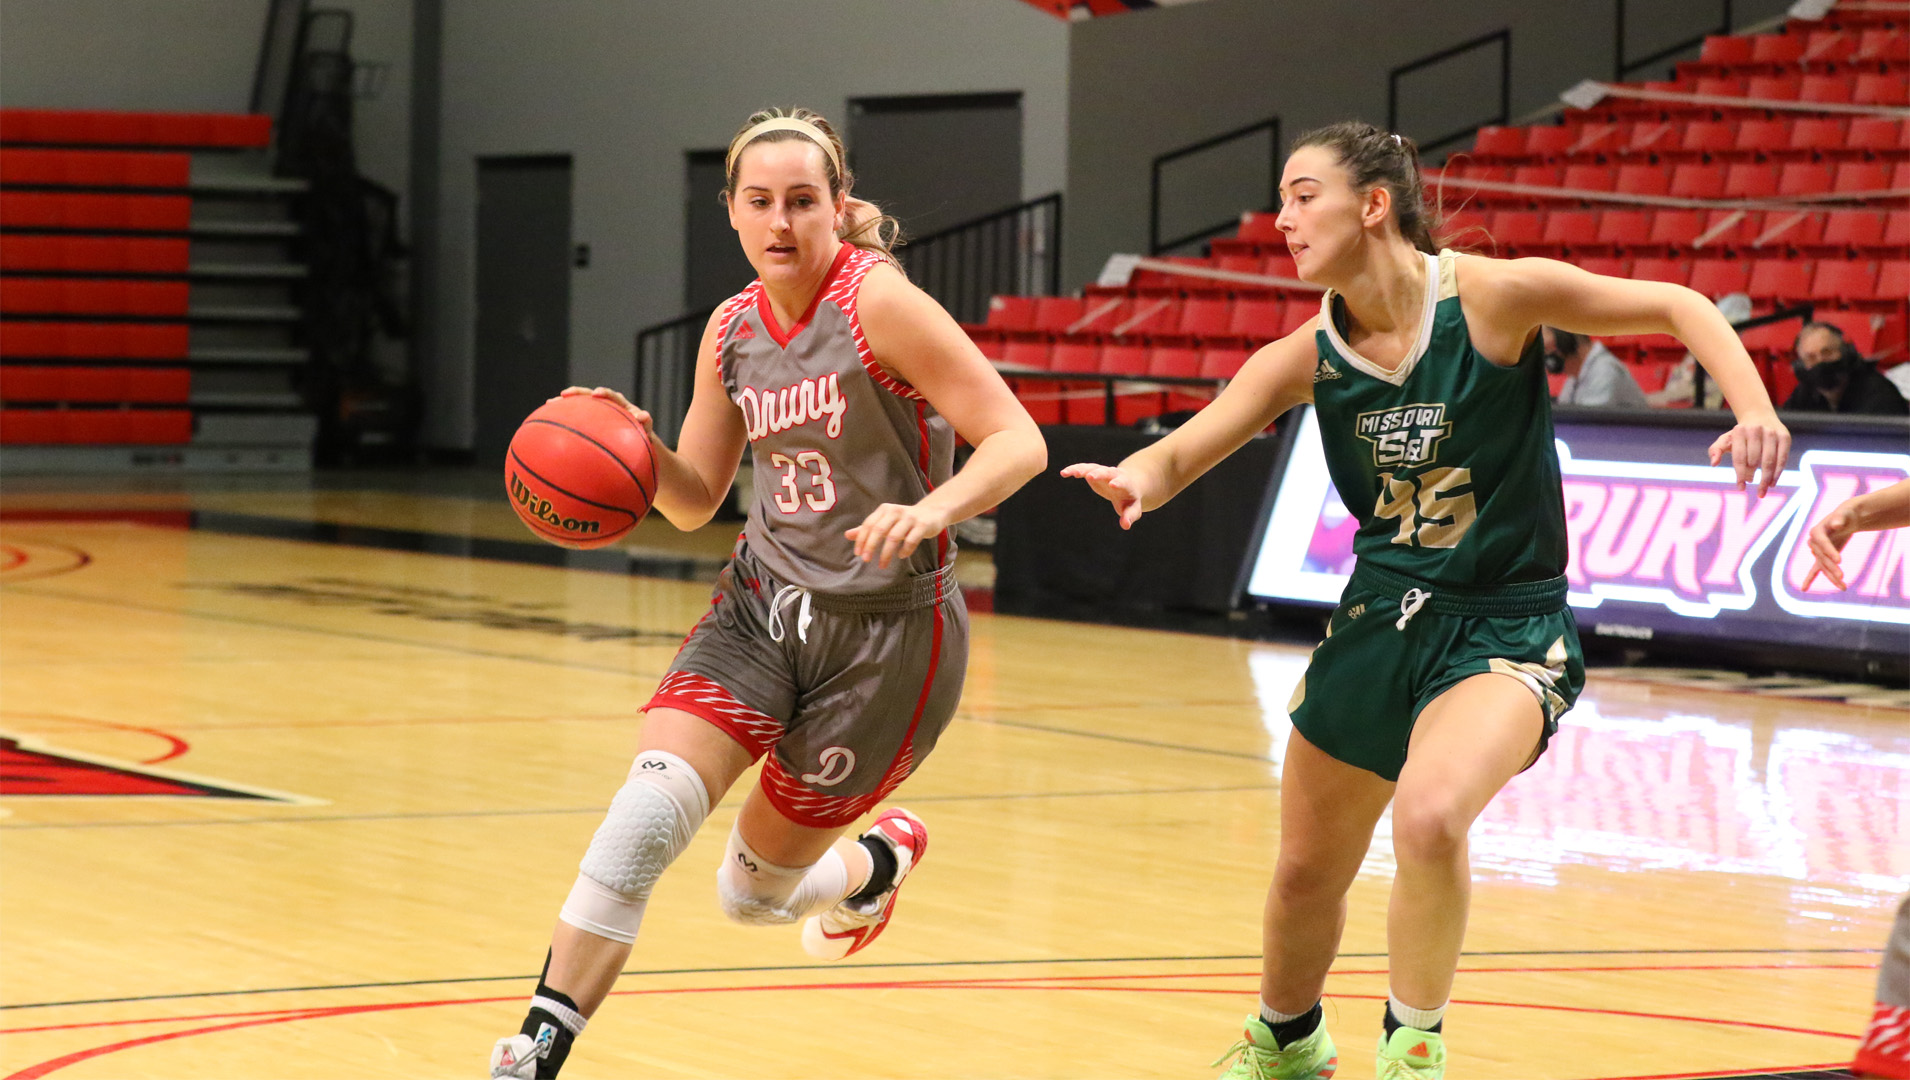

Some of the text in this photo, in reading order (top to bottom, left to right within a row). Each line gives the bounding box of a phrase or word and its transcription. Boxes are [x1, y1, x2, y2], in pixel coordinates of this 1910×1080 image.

[736, 372, 848, 443] Drury
[1360, 408, 1441, 434] MISSOURI
[1376, 428, 1445, 464] S&T
[511, 471, 600, 533] Wilson
[769, 450, 838, 514] 33
[1374, 466, 1478, 549] 45
[801, 745, 857, 788] D
